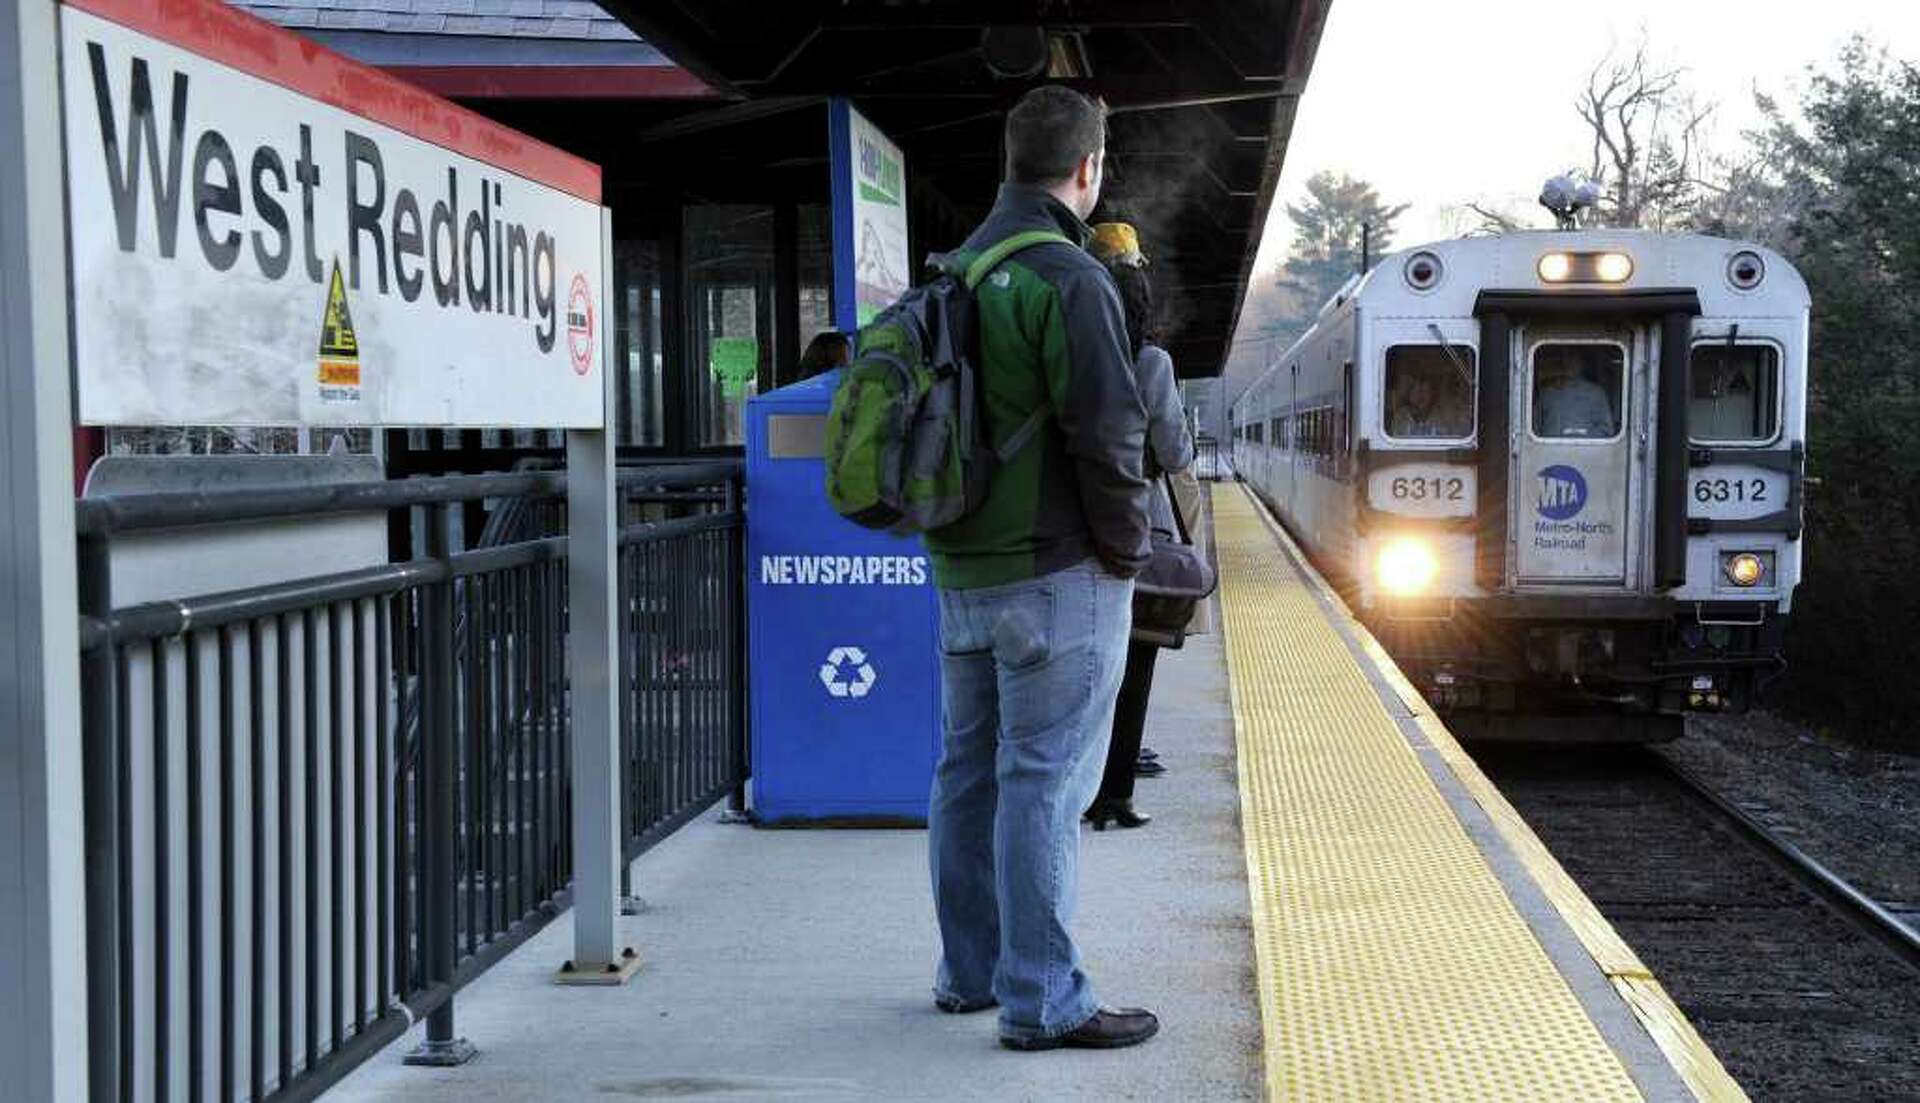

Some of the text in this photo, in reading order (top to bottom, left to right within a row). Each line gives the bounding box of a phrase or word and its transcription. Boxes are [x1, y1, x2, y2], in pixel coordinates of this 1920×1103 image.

[87, 41, 323, 283] West
[345, 129, 557, 354] Redding
[1392, 478, 1464, 499] 6312
[1536, 473, 1582, 514] MTA
[1694, 480, 1767, 502] 6312
[1535, 537, 1586, 550] Railroad
[762, 555, 926, 585] NEWSPAPERS
